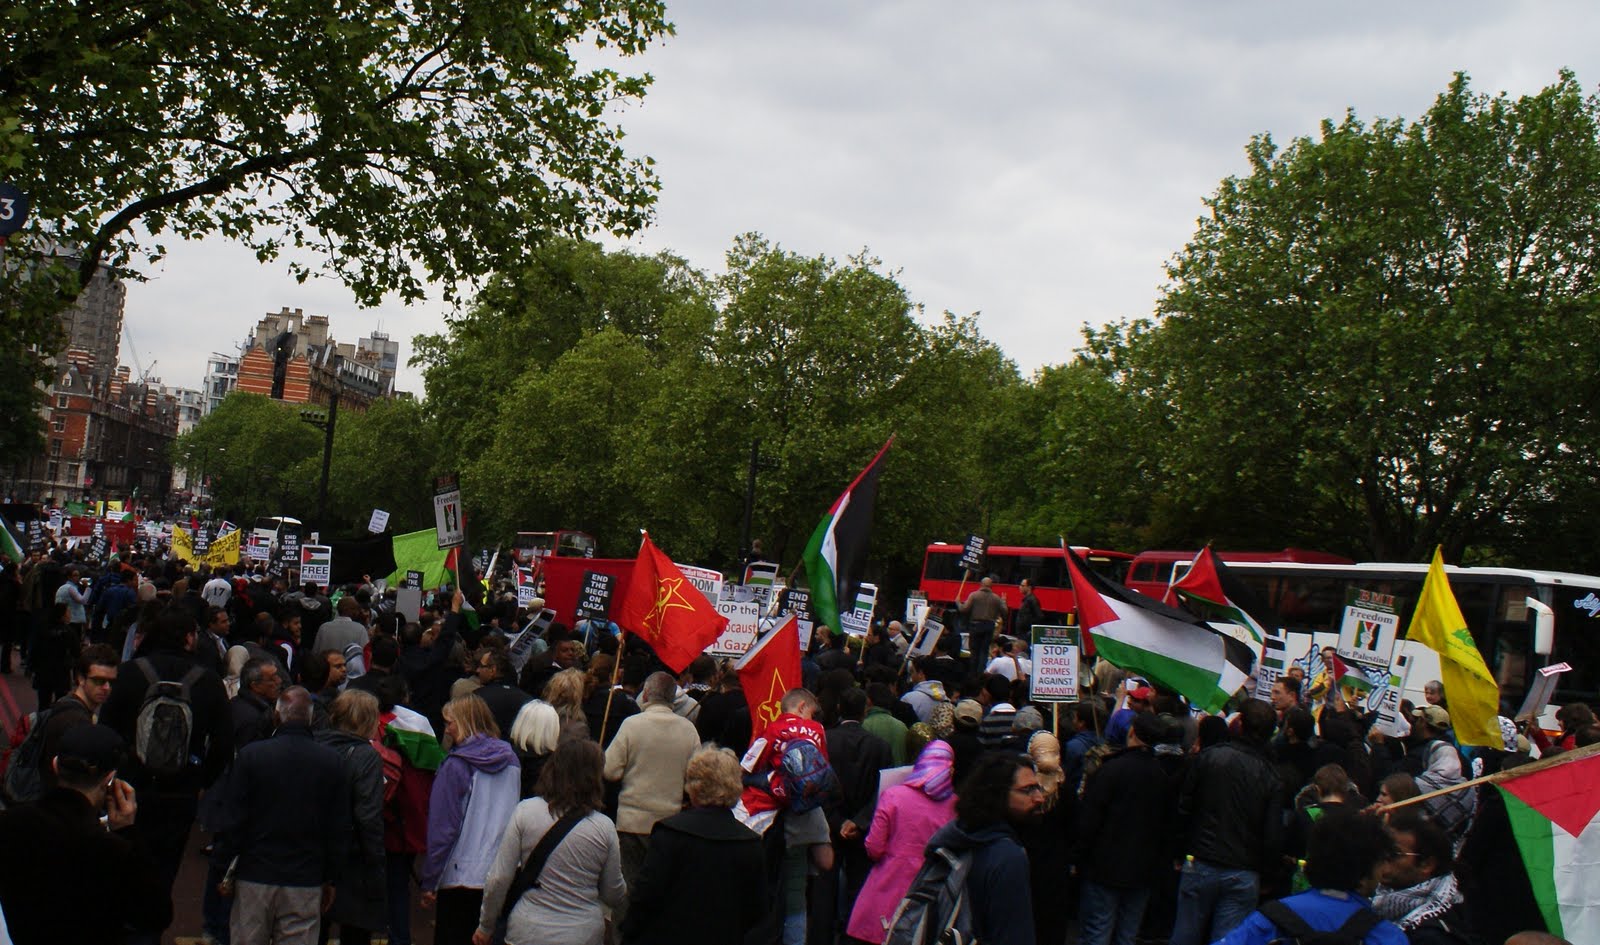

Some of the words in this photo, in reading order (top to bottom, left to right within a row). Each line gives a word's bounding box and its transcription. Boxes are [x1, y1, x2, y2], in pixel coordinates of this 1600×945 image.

[0, 198, 15, 220] 3
[302, 566, 329, 575] FREE
[591, 573, 609, 583] END
[590, 580, 607, 590] THE
[692, 578, 714, 592] DOM
[213, 587, 225, 597] 17
[584, 586, 609, 598] SIEGE
[788, 591, 809, 602] END
[589, 595, 602, 603] ON
[582, 601, 605, 611] GAZA
[718, 603, 738, 613] TOP
[740, 604, 758, 616] the
[787, 600, 807, 611] THE
[781, 608, 810, 620] SGE
[1349, 608, 1394, 625] Freedom
[725, 624, 757, 635] ocaust
[1043, 645, 1070, 656] STOP
[1041, 657, 1071, 667] ISRAELI
[1338, 648, 1350, 658] for
[1352, 651, 1389, 667] Palestine
[1040, 667, 1071, 677] CRIMES
[1038, 677, 1074, 686] AGAINST
[1034, 687, 1076, 696] HUMANITY
